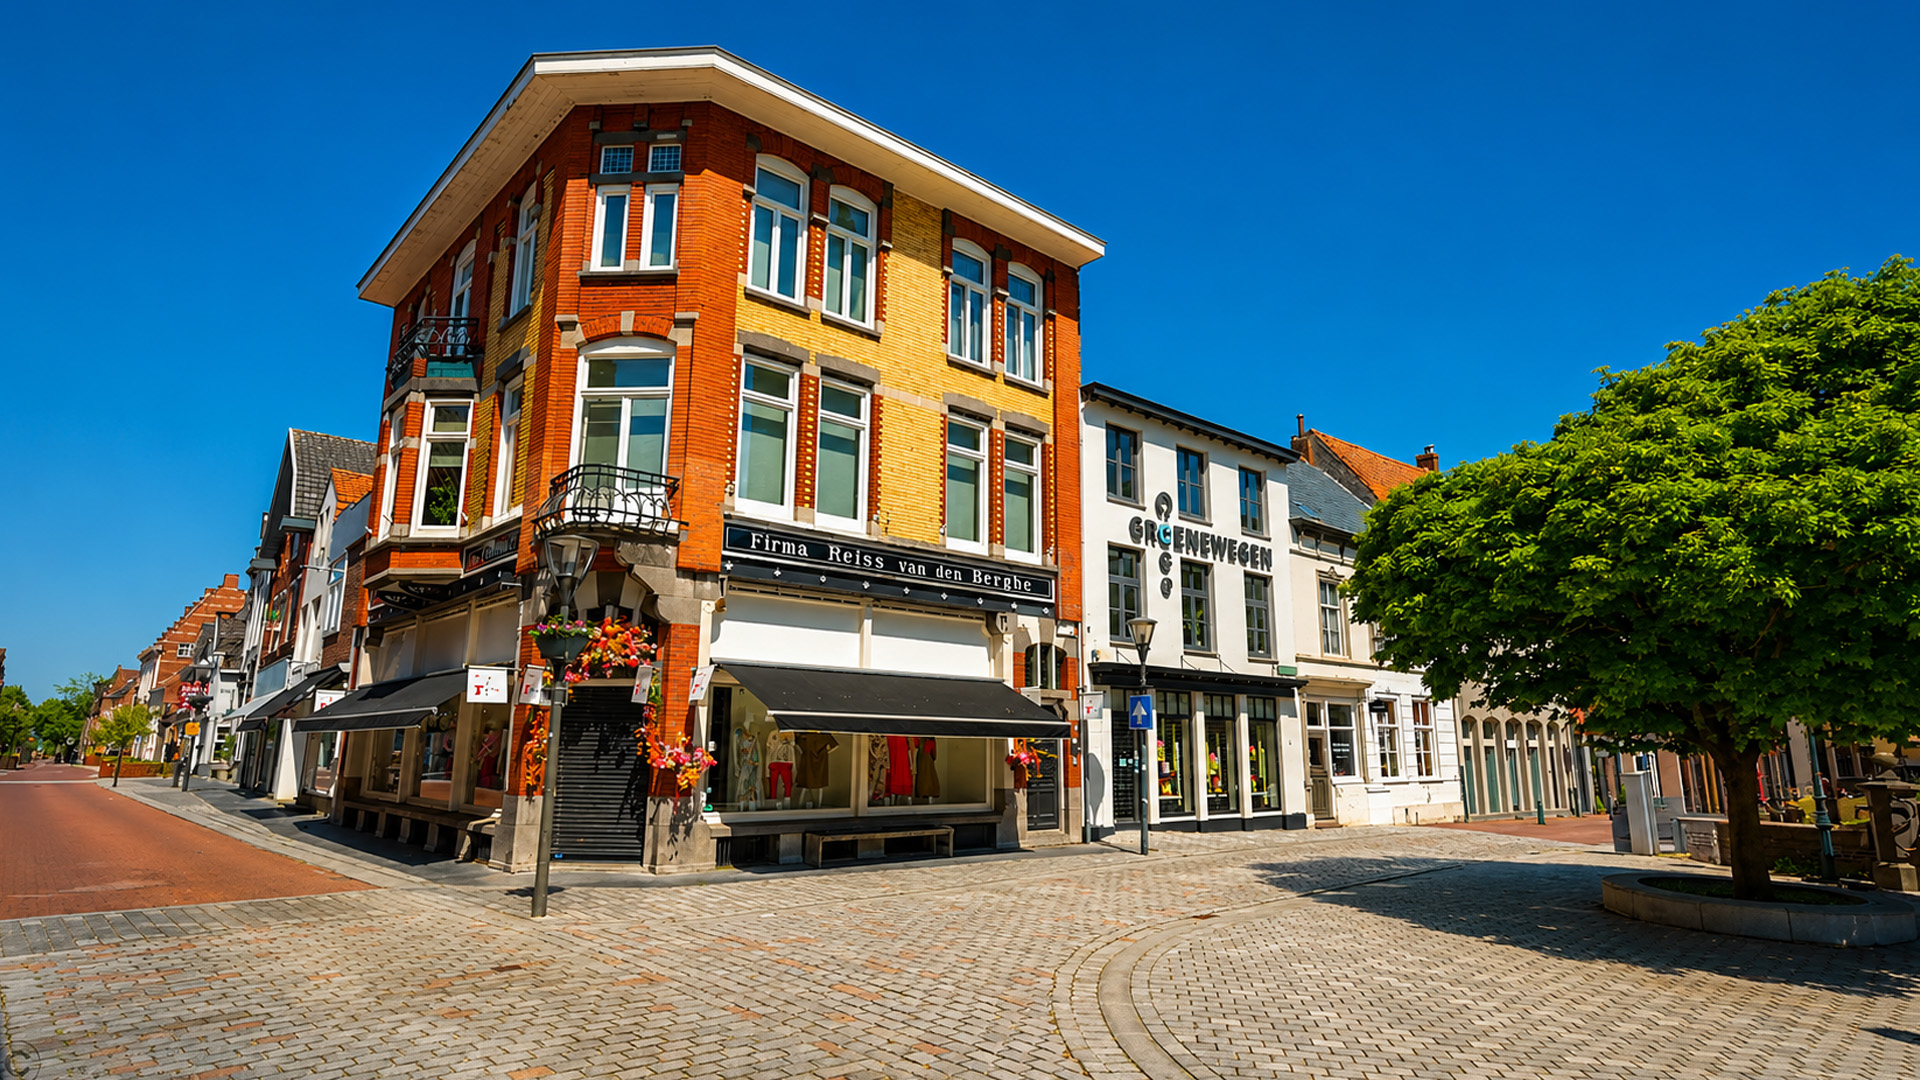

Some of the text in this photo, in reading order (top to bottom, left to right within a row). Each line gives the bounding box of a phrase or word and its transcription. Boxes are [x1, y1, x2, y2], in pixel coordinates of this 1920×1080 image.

[750, 533, 1032, 593] Firma Reiss van den Berghe
